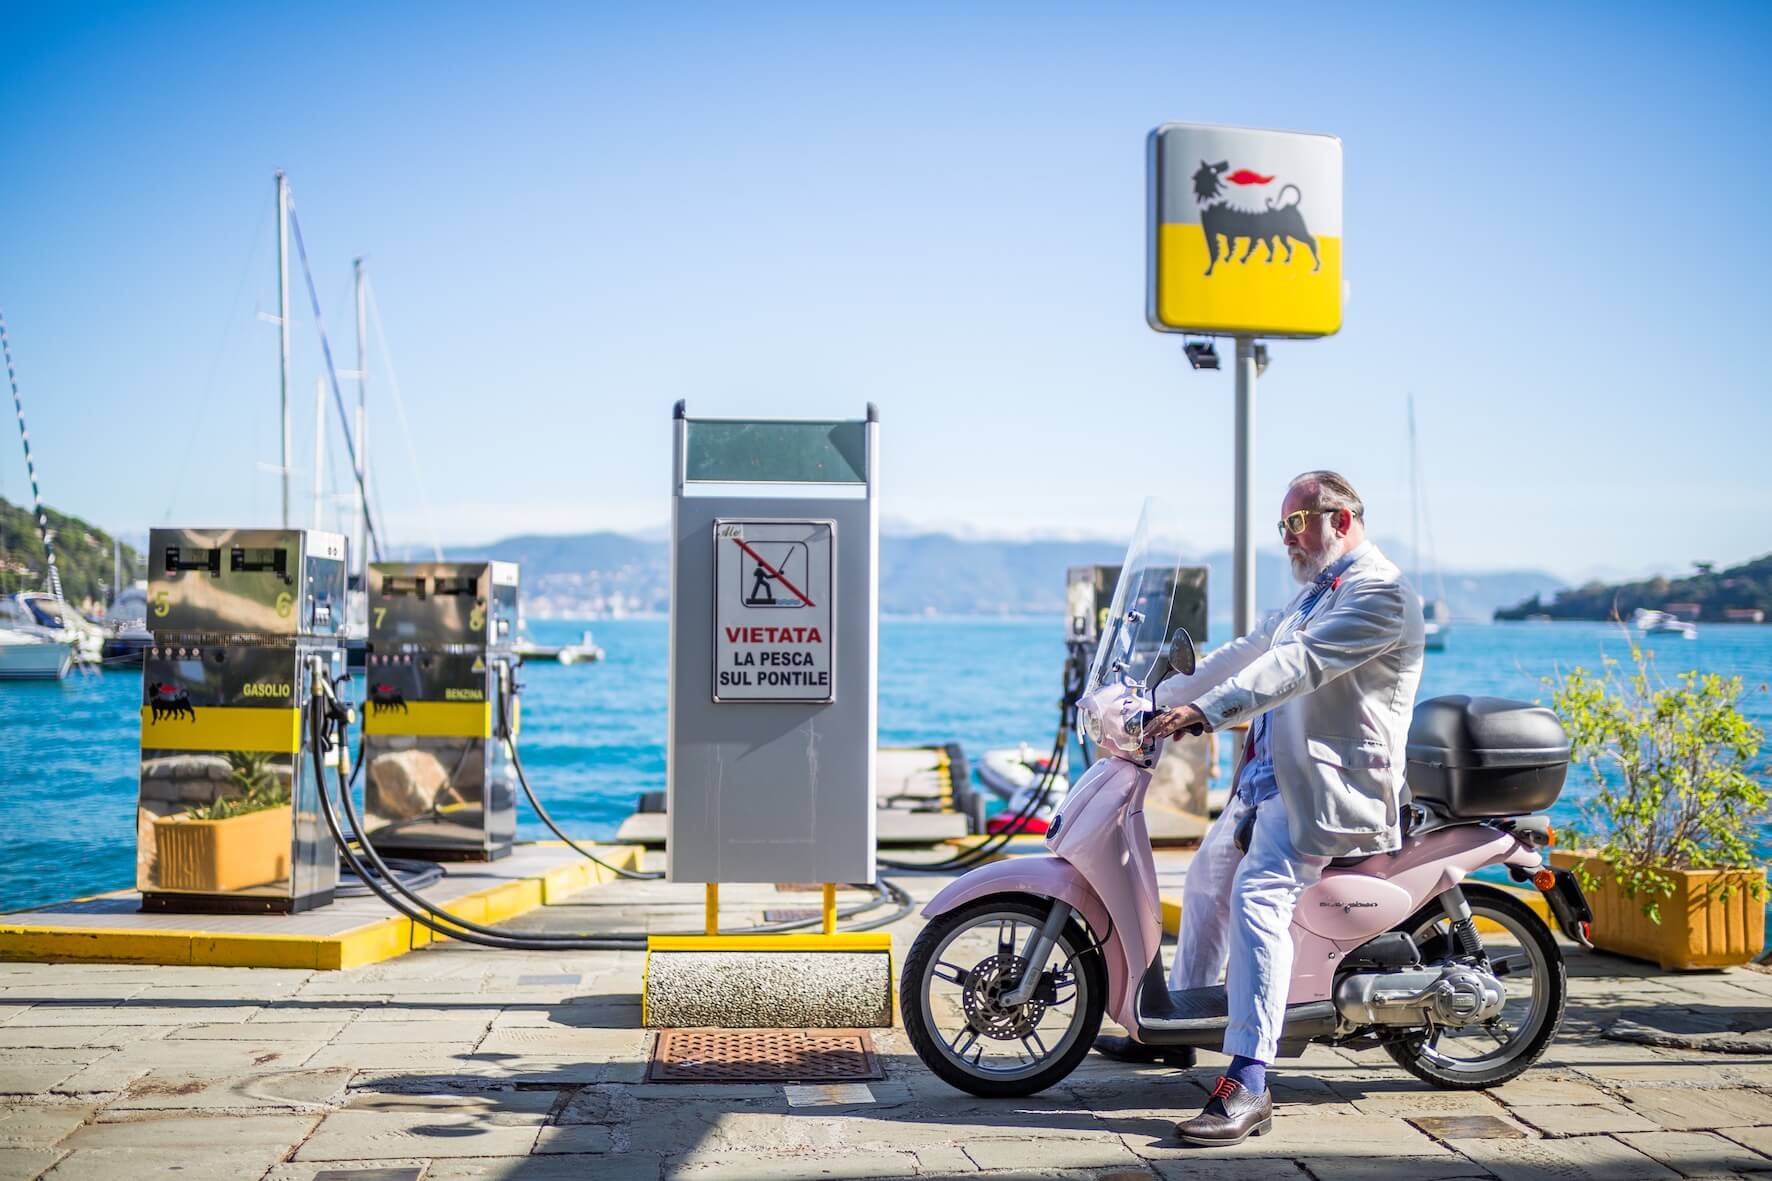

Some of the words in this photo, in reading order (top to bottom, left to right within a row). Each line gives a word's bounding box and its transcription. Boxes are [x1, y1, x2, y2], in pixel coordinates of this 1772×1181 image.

[154, 591, 170, 617] 5
[276, 592, 292, 617] 6
[374, 607, 387, 629] 7
[725, 627, 822, 643] VIETATA
[734, 652, 754, 666] LA
[760, 652, 814, 666] PESCA
[720, 671, 752, 686] SUL
[758, 671, 828, 686] PONTILE
[243, 683, 290, 697] GASOLIO
